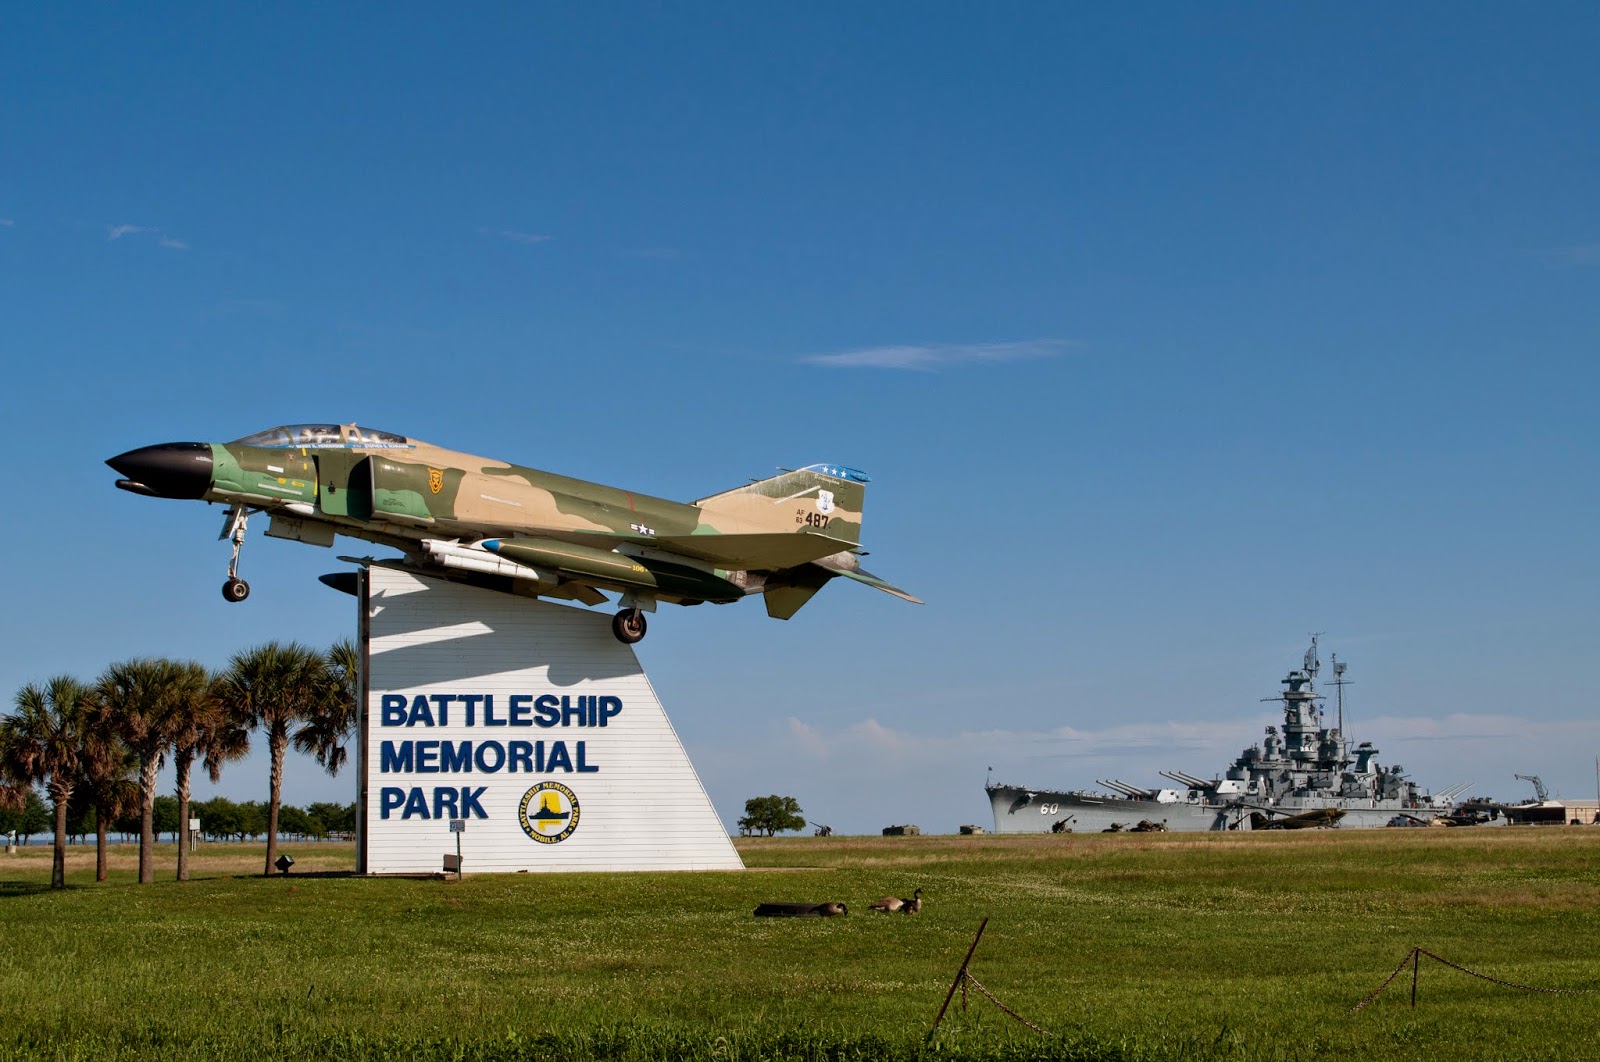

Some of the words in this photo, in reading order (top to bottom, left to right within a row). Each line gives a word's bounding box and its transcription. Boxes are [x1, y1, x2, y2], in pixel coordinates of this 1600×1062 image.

[805, 512, 829, 529] 487
[381, 694, 623, 727] BATTLESHIP
[380, 740, 599, 774] MEMORIAL
[380, 787, 489, 820] PARK
[520, 785, 541, 828] BATTLESHIP
[542, 782, 577, 805] MEMORIAL
[570, 807, 579, 828] PARK
[1040, 803, 1059, 815] 60
[560, 831, 570, 840] AL
